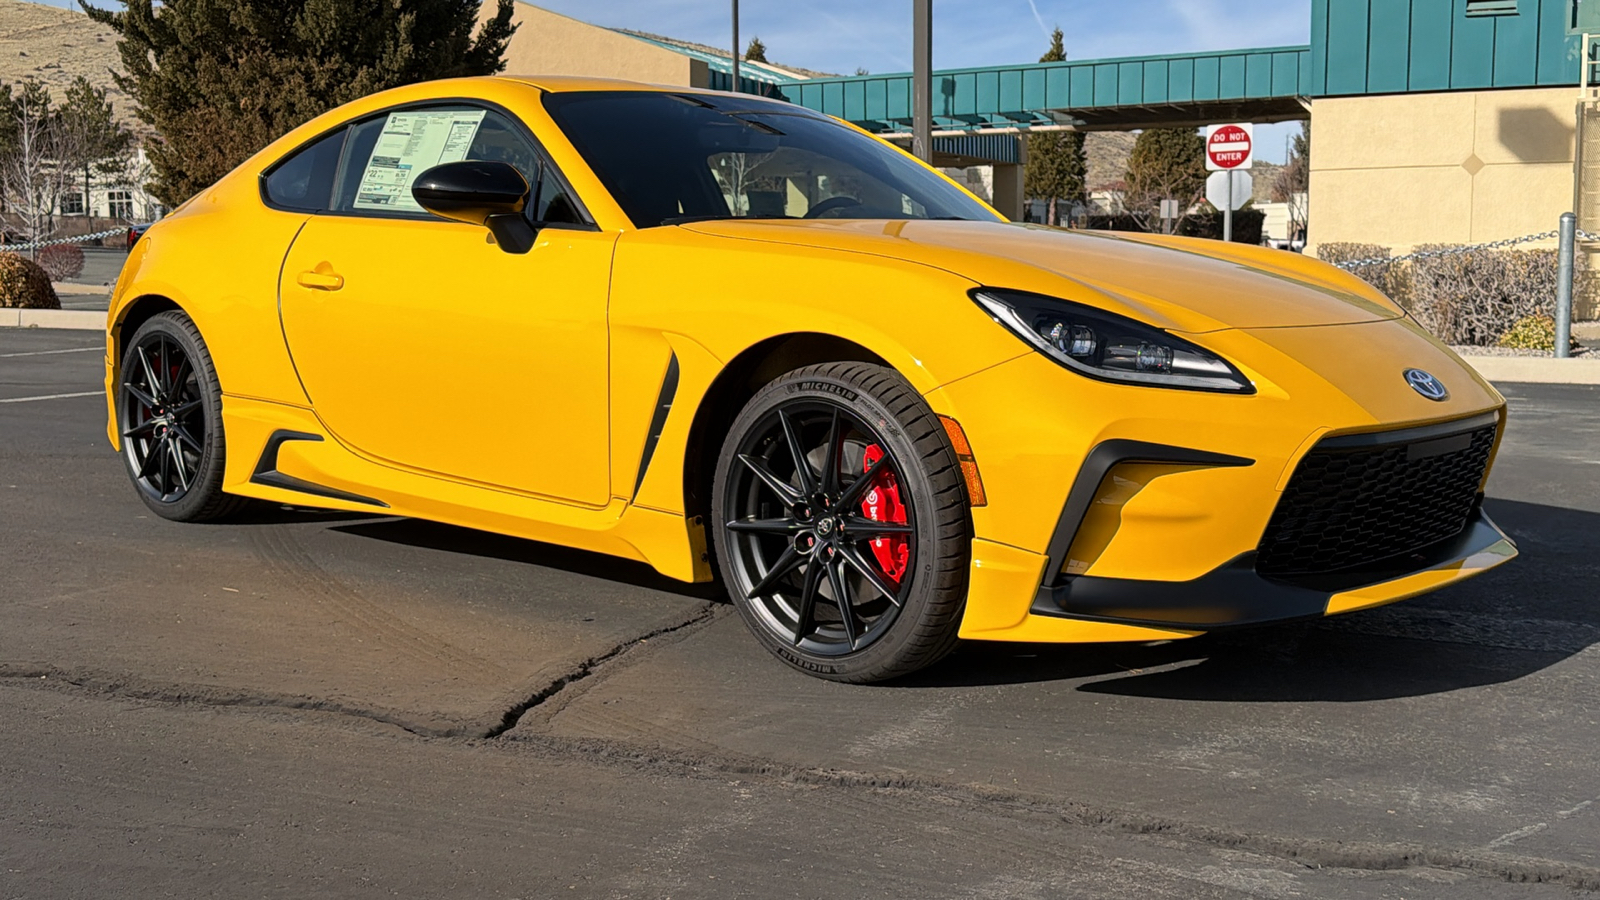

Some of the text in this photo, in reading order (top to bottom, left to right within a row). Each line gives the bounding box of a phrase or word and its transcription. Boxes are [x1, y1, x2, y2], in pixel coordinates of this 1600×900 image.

[1213, 132, 1246, 142] DO NOT
[1216, 152, 1242, 161] ENTER
[801, 382, 856, 399] MICHELIN
[860, 399, 874, 410] PILOT
[780, 650, 832, 673] MICHELIN
